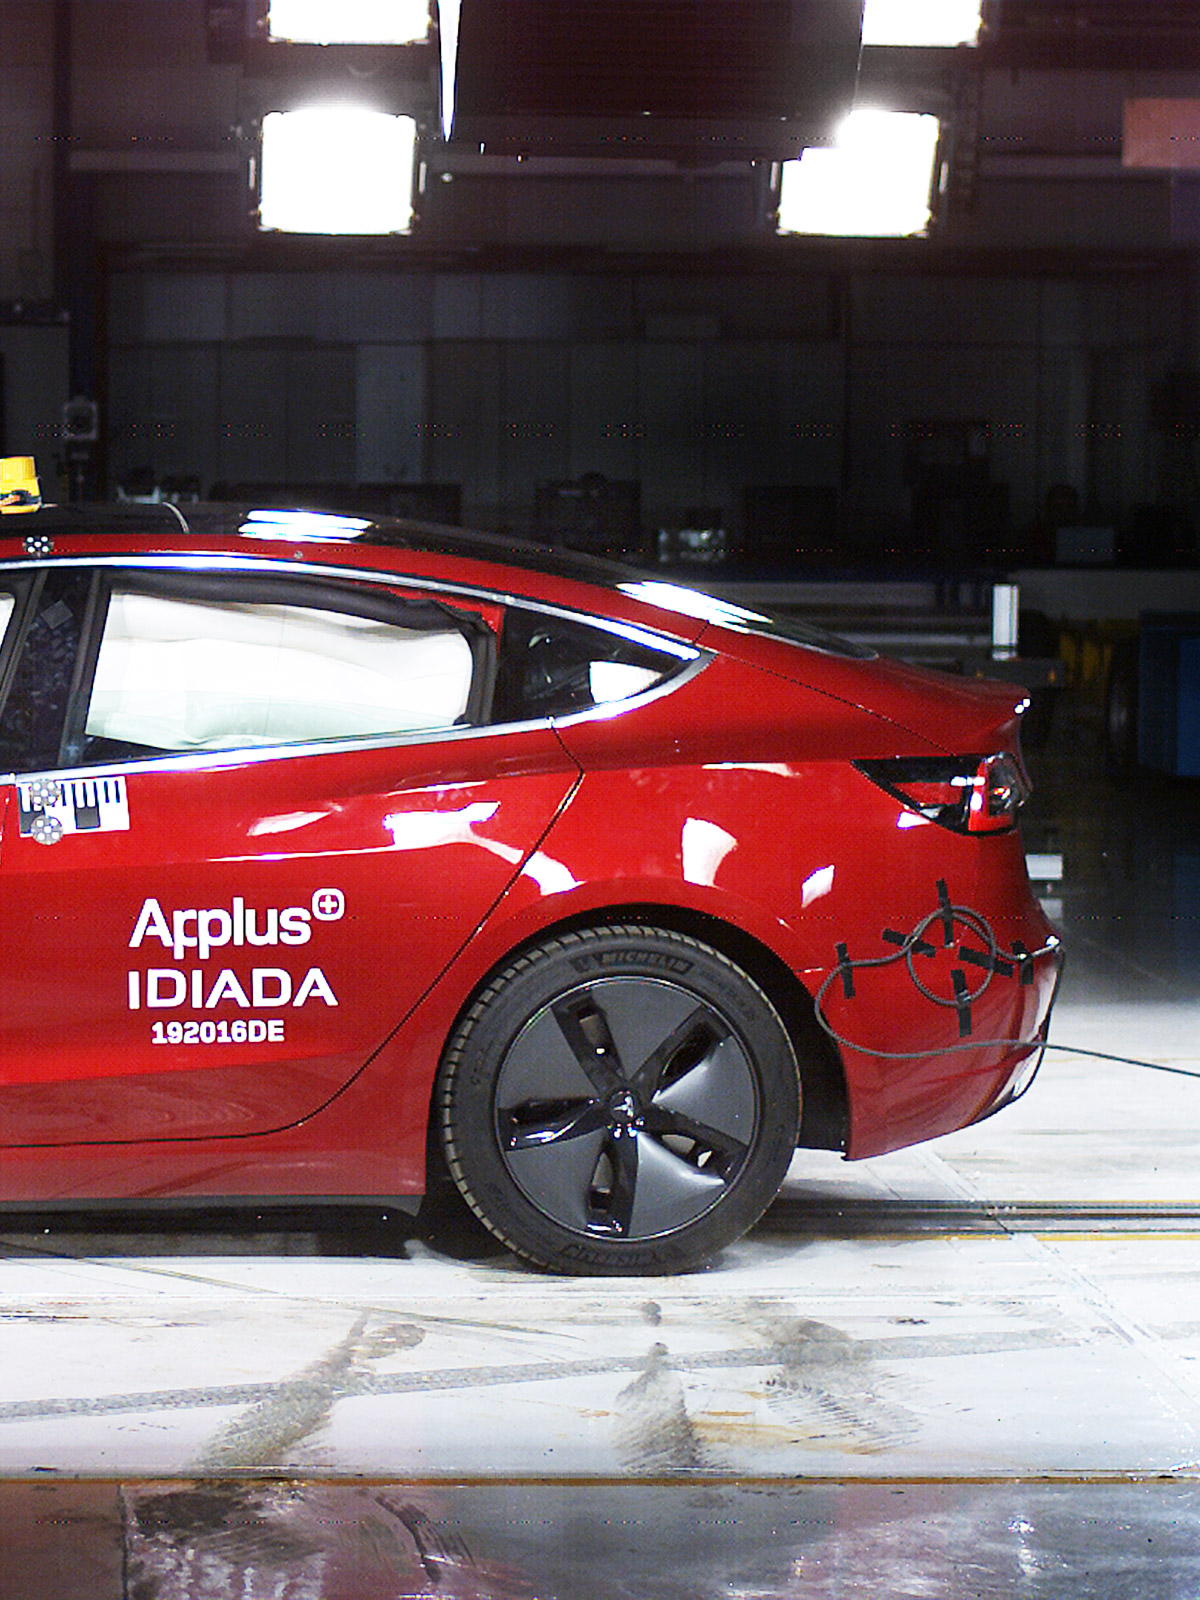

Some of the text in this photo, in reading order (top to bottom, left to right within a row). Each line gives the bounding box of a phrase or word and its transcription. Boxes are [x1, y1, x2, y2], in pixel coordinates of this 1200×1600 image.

[601, 949, 693, 974] MICHELIN
[128, 966, 339, 1010] IDIADA
[151, 1019, 285, 1045] 192016DE
